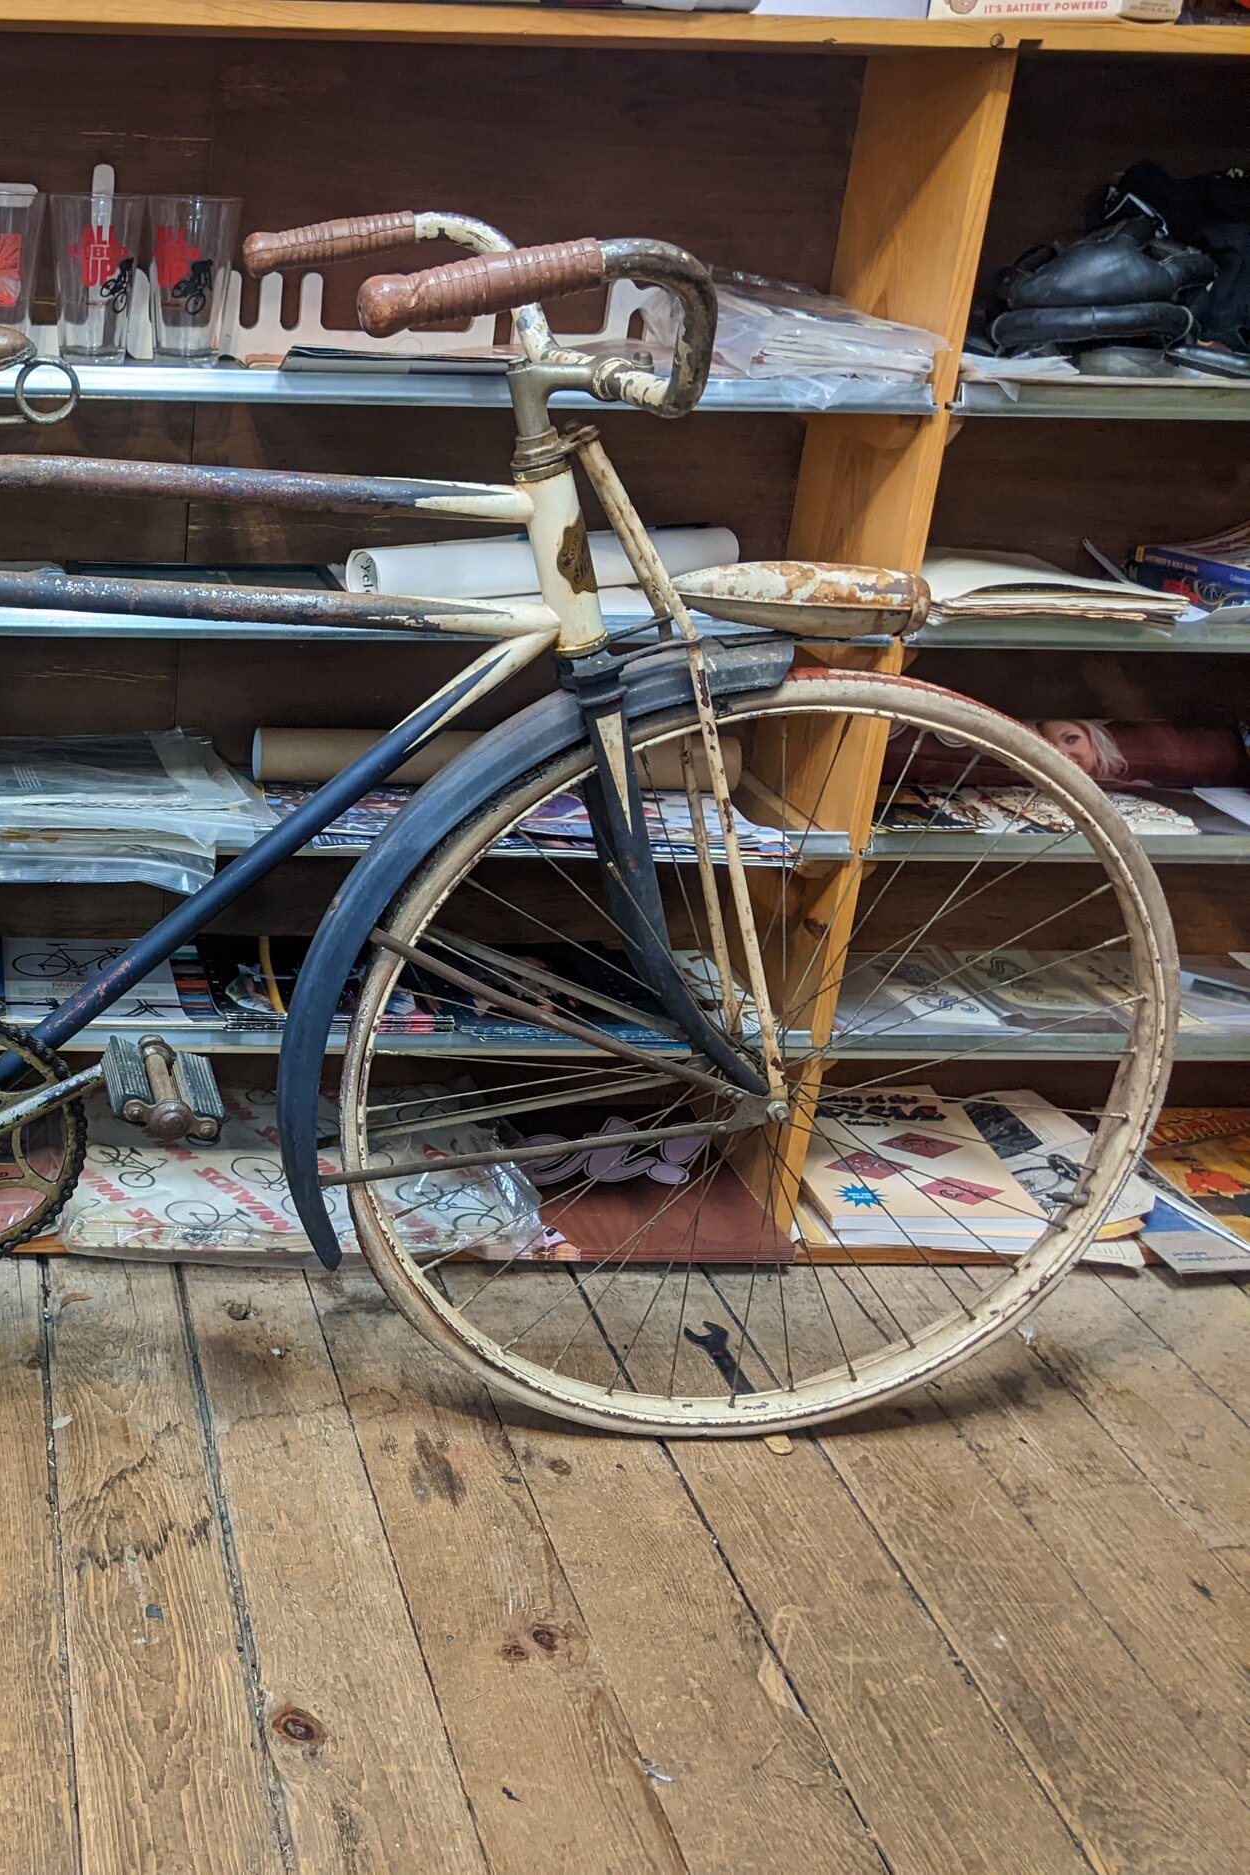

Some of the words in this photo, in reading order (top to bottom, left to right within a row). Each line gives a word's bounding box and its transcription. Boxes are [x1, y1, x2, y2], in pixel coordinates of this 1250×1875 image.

[983, 4, 1002, 14] IT'S
[1006, 3, 1049, 13] BATTERY
[1053, 1, 1108, 12] POWERED
[80, 224, 119, 246] ALL
[80, 258, 118, 288] UP
[193, 1166, 297, 1231] SCHWINN
